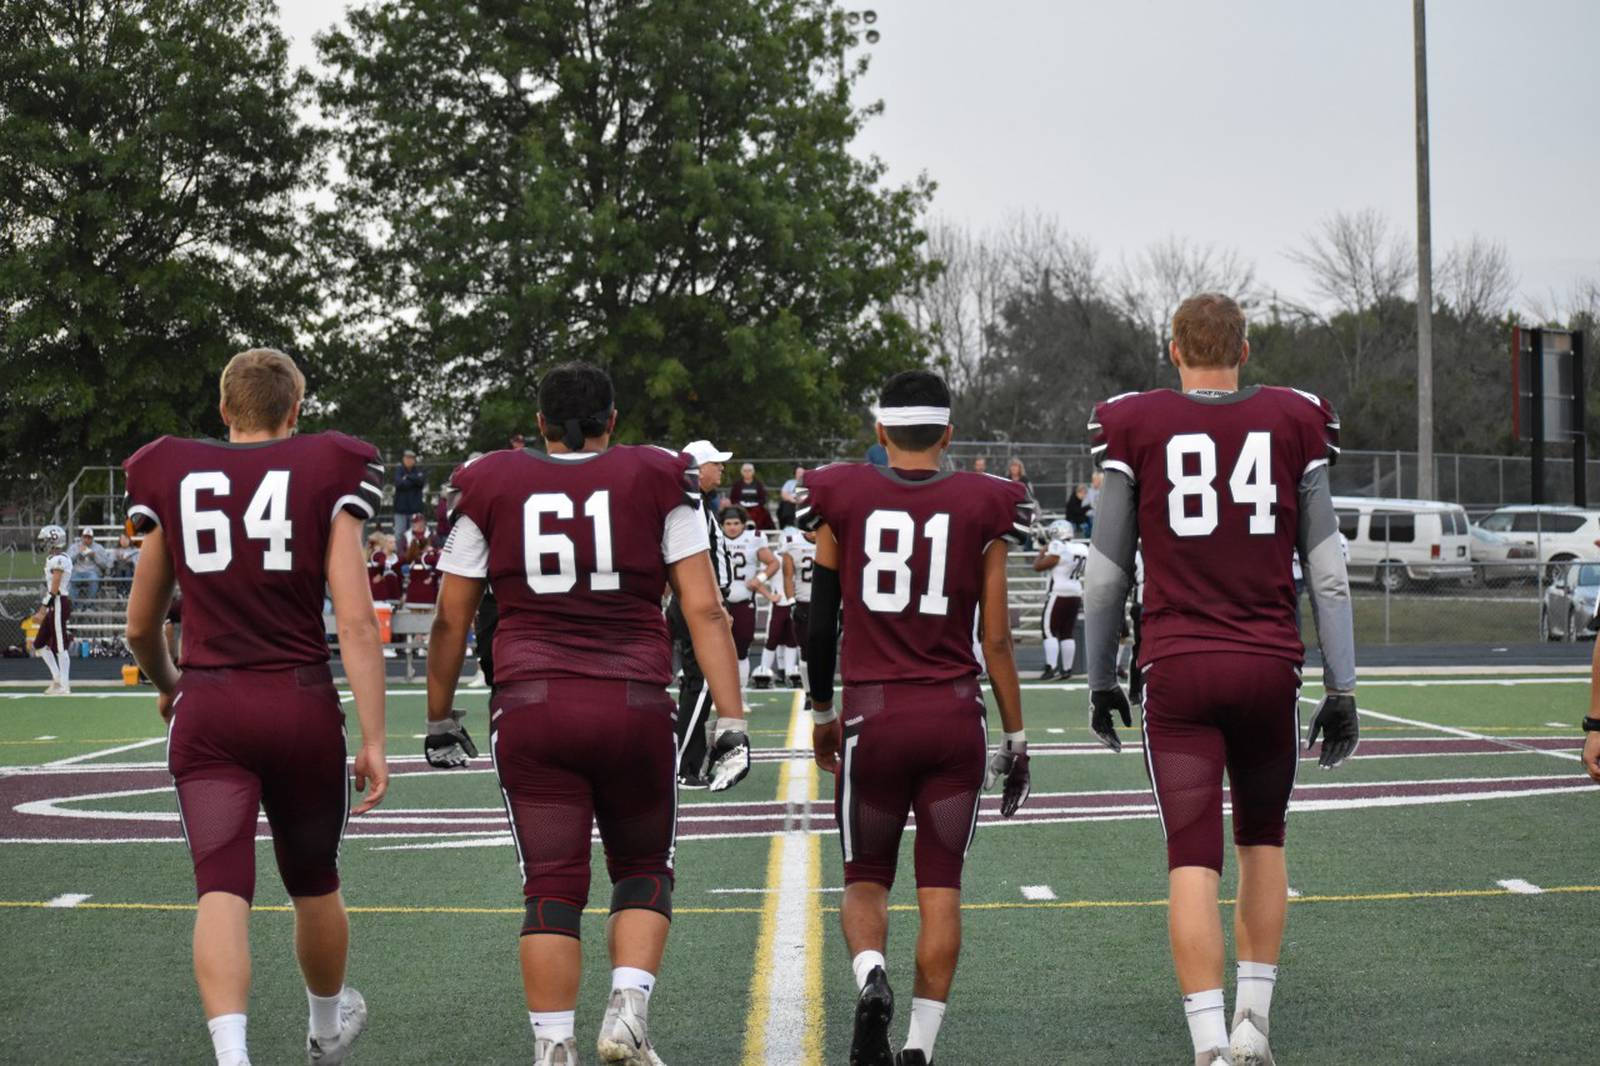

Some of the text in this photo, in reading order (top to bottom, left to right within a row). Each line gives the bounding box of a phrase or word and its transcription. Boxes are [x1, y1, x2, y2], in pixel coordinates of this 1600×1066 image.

[180, 470, 293, 573] 64
[1166, 431, 1277, 537] 84
[523, 490, 620, 594] 61
[730, 552, 747, 581] 2
[801, 556, 815, 583] 2
[862, 509, 950, 616] 81
